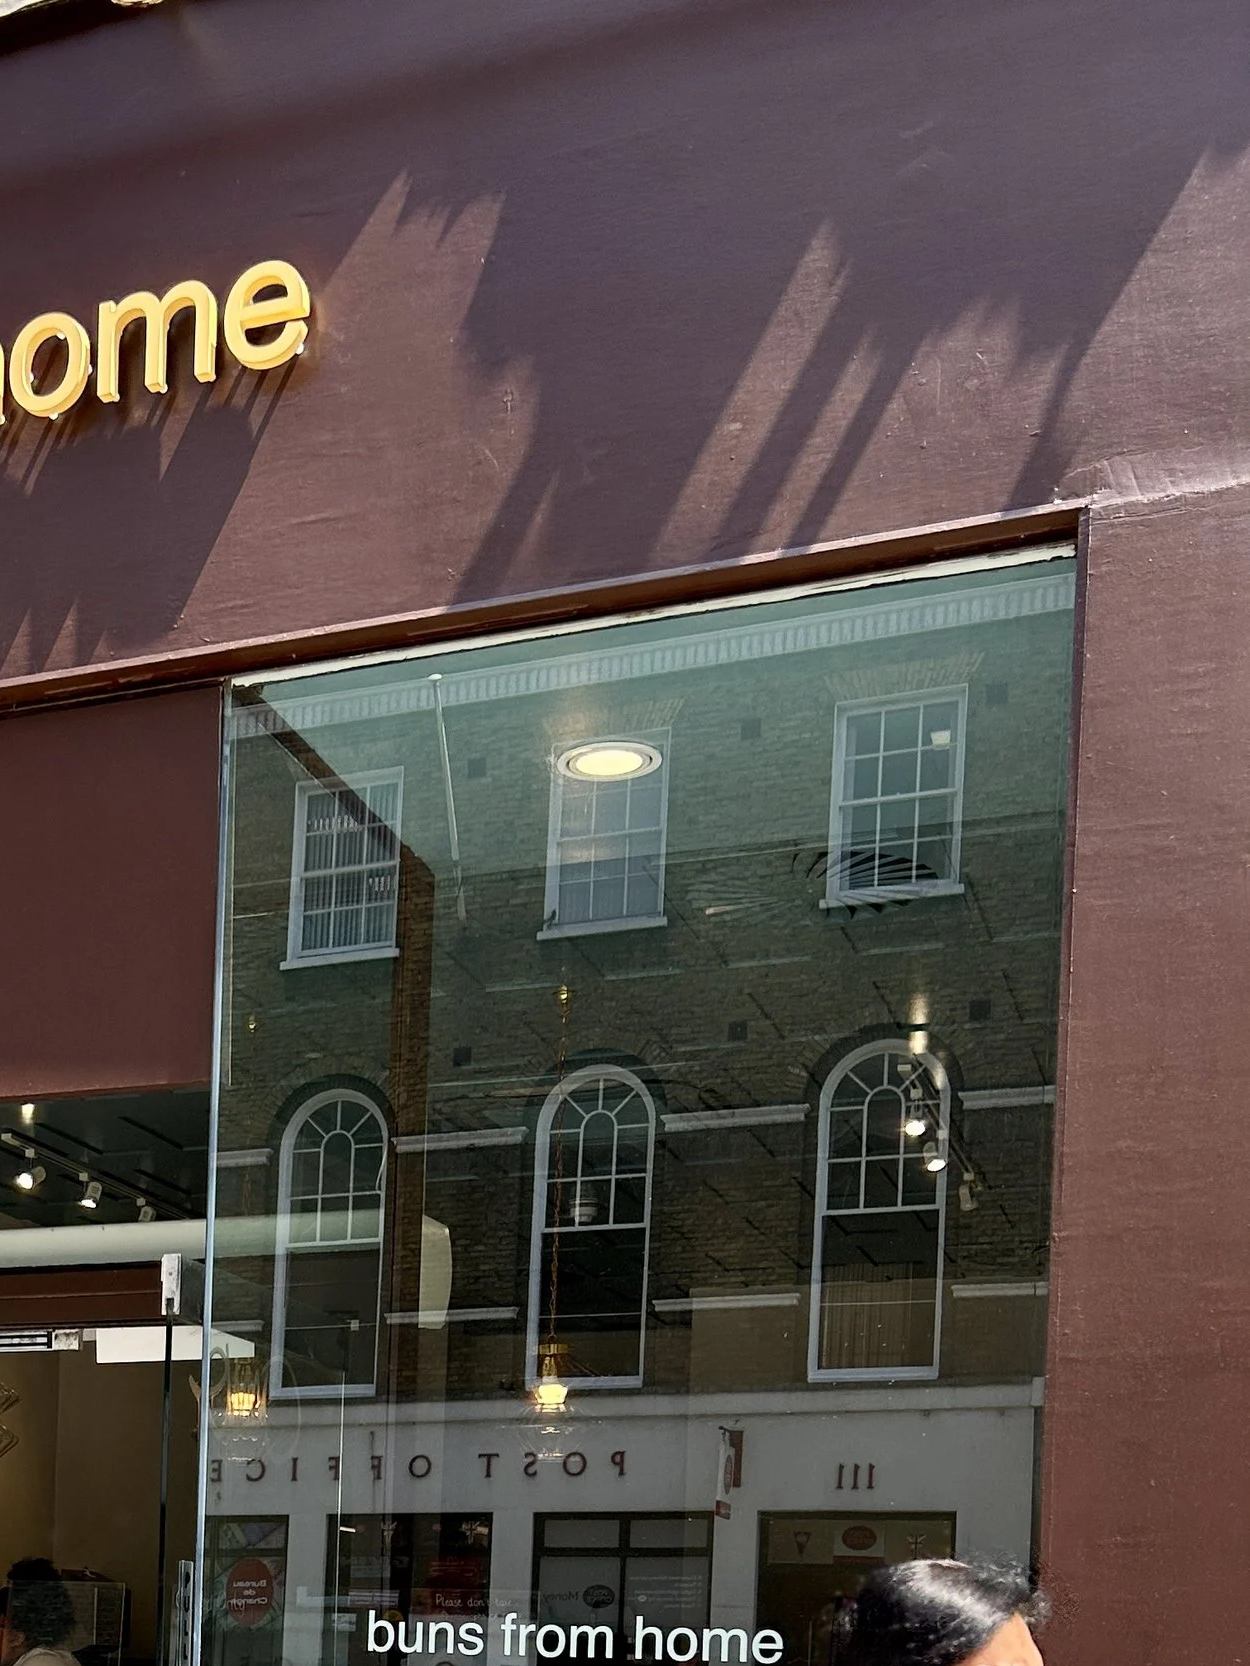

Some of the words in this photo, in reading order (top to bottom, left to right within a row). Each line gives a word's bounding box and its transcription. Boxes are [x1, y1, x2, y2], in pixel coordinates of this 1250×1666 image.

[435, 1593, 462, 1607] Please
[367, 1610, 484, 1656] buns
[501, 1612, 613, 1658] from
[634, 1616, 784, 1664] home
